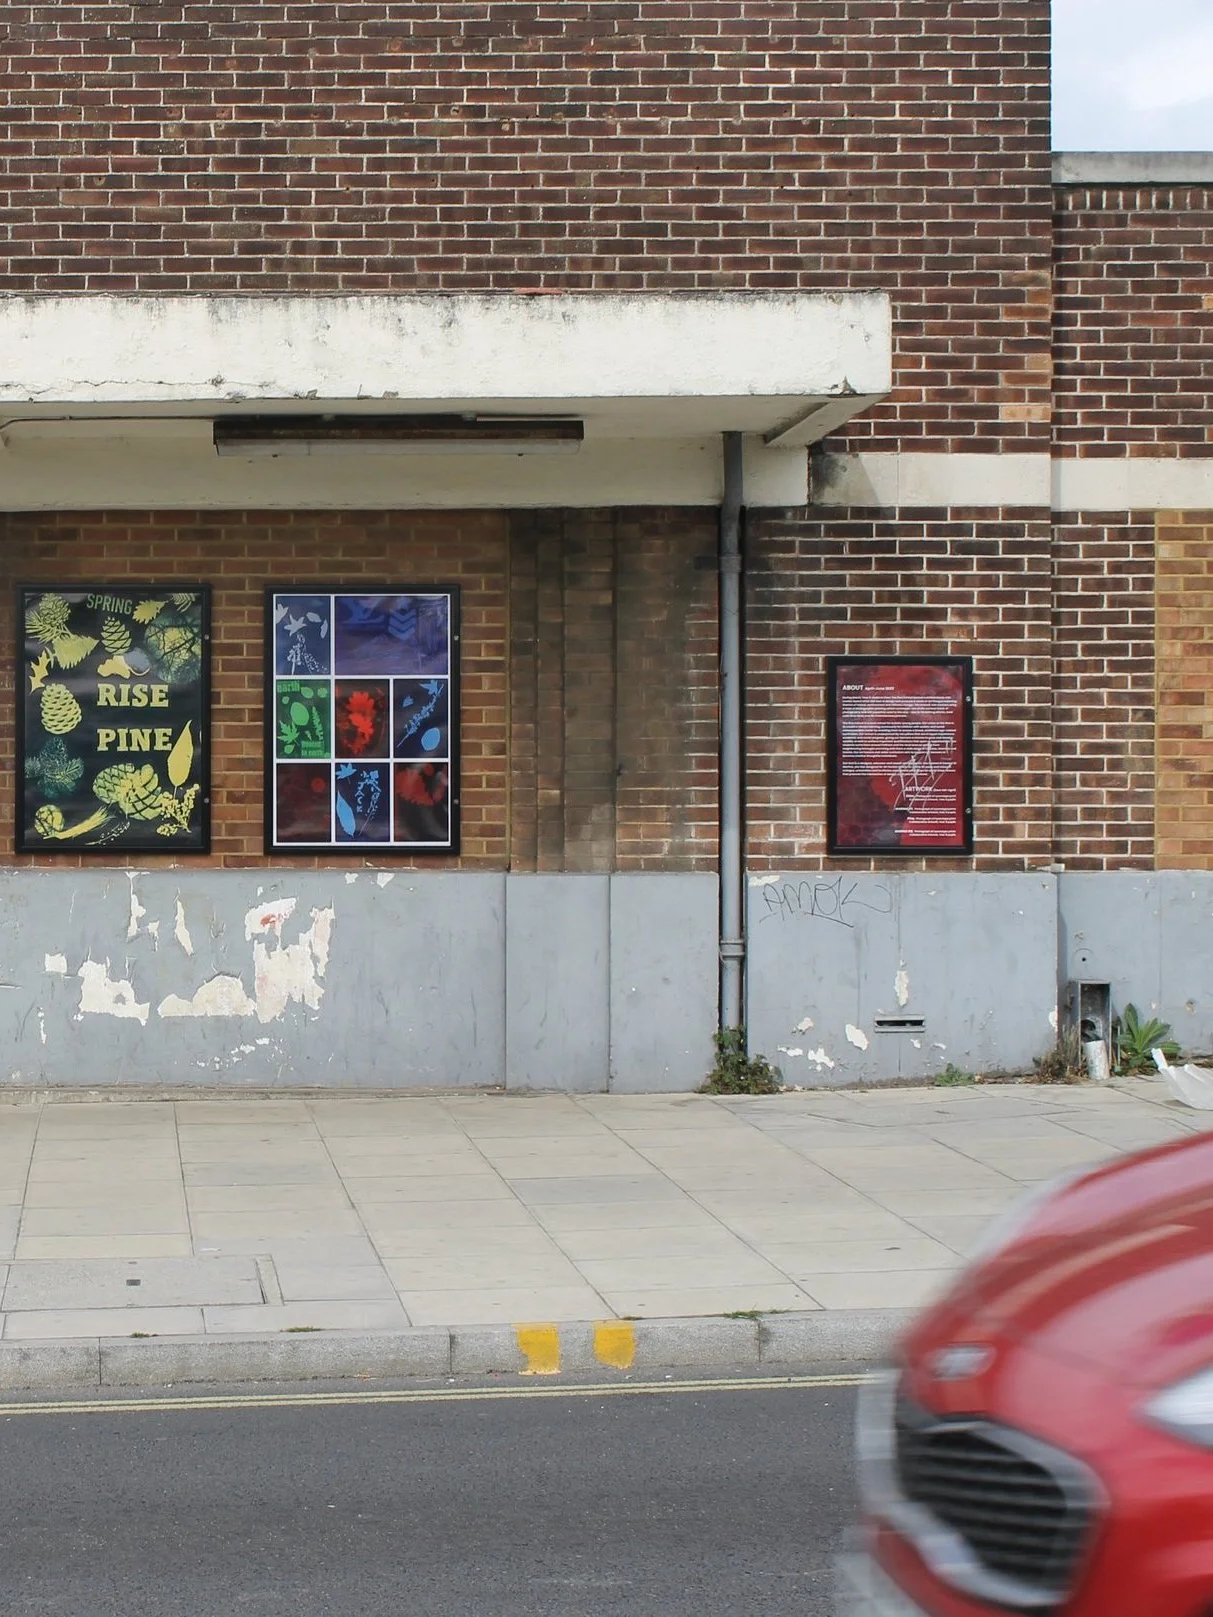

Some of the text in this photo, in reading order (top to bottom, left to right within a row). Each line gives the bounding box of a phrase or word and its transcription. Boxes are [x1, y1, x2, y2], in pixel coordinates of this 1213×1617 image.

[86, 592, 133, 615] SPRING
[97, 683, 170, 708] RISE
[97, 728, 172, 752] PINE
